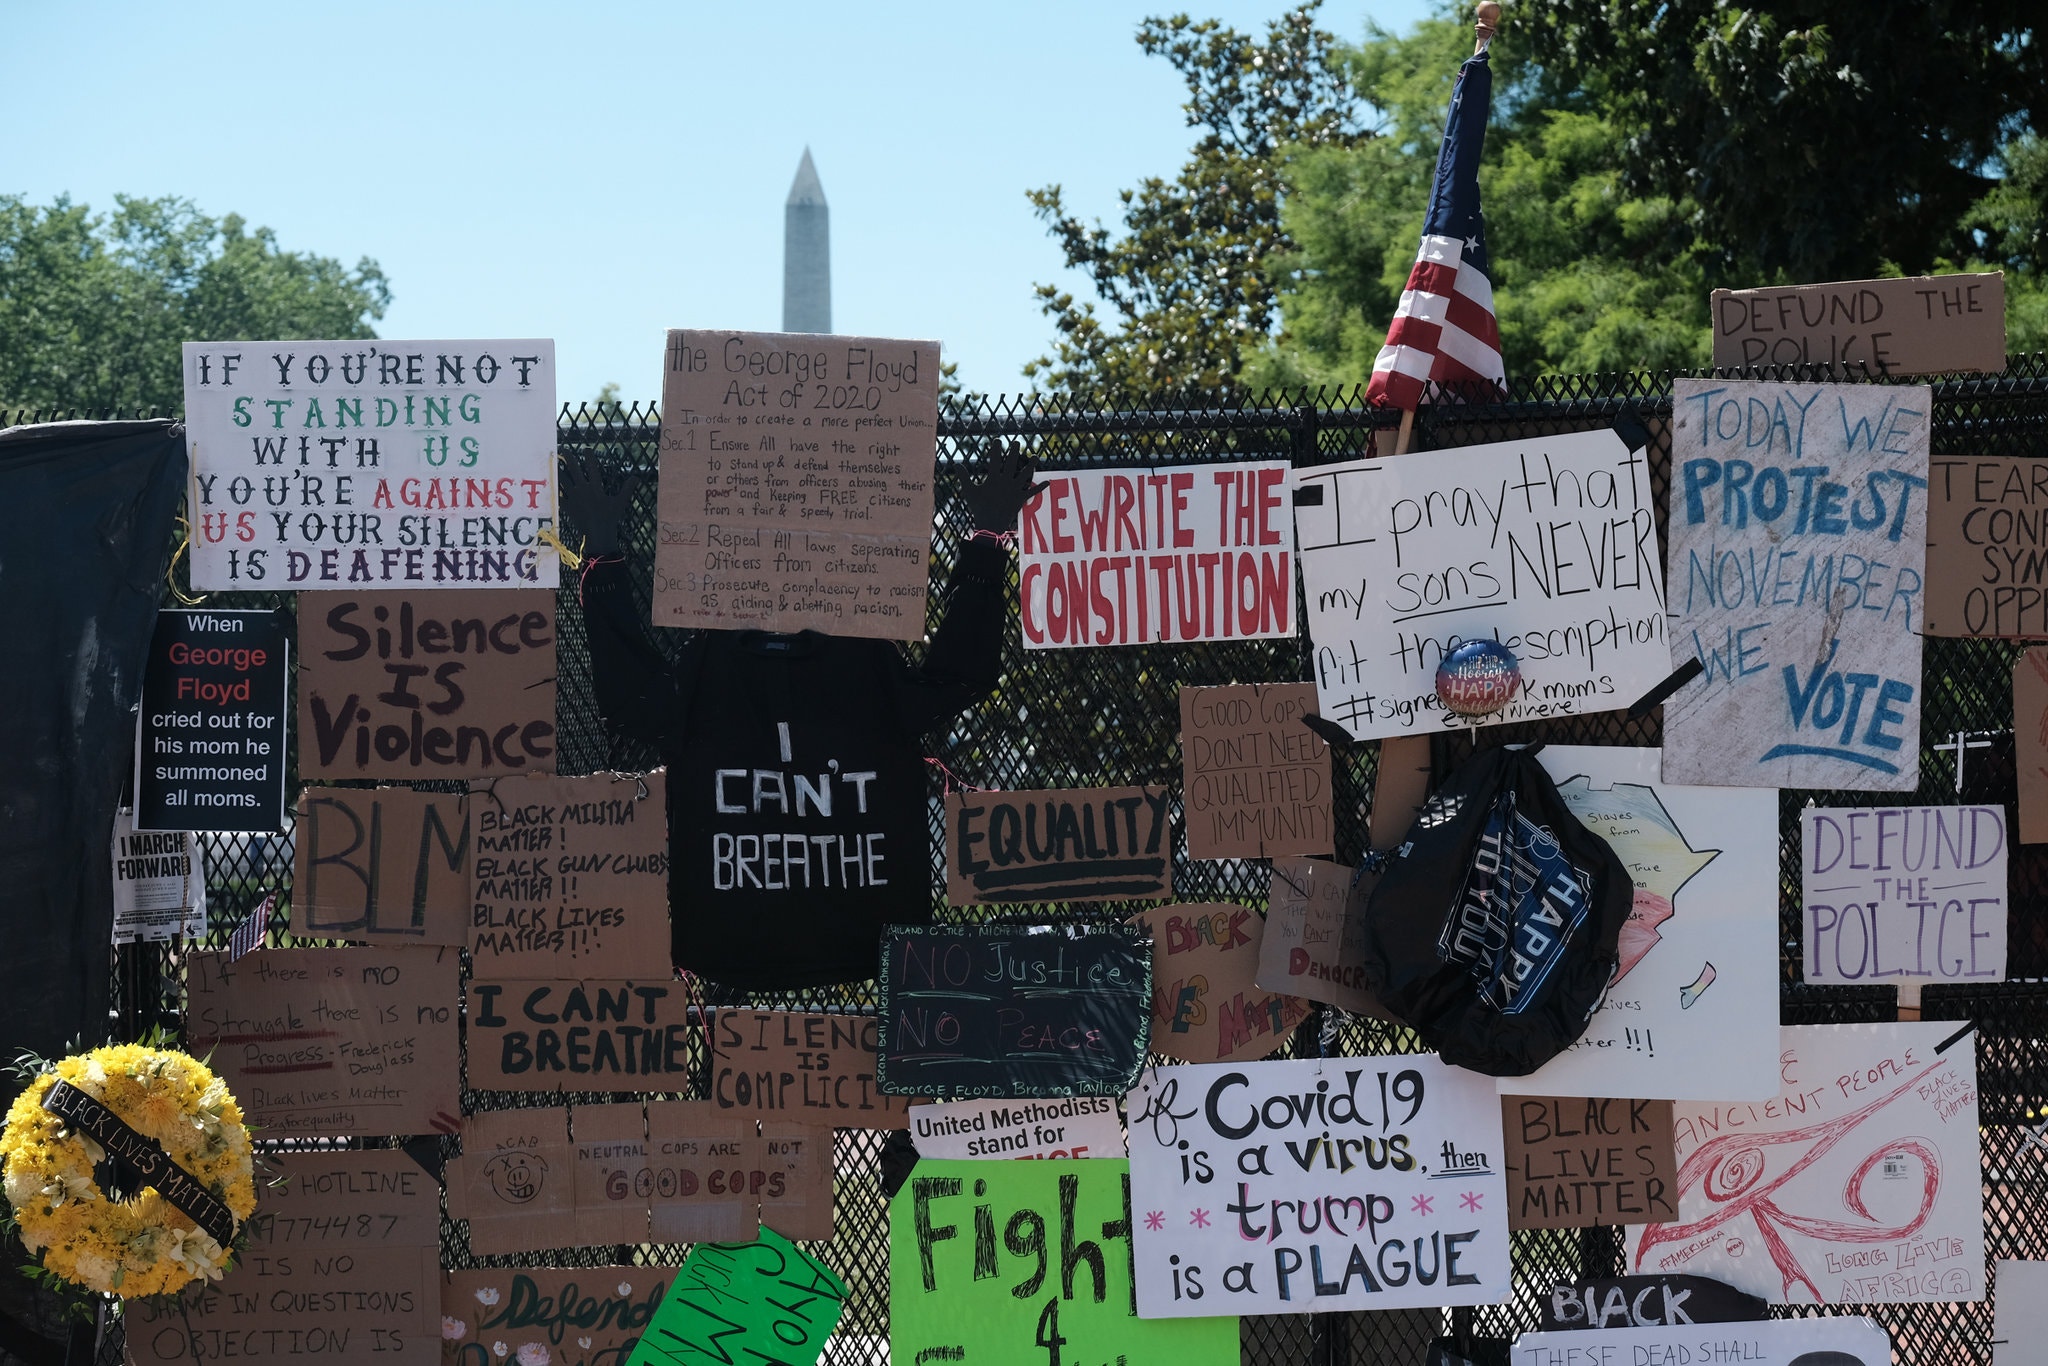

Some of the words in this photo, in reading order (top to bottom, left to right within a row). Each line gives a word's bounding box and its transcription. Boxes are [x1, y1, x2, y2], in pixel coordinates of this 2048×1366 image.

[1720, 290, 1883, 336] DEFUND
[1915, 284, 1983, 319] THE
[200, 353, 242, 386] IF
[272, 347, 425, 387] YOU'RE
[436, 352, 541, 387] NOT
[669, 334, 707, 373] the
[724, 337, 827, 382] George
[847, 348, 918, 393] Floyd
[232, 393, 482, 428] STANDING
[724, 381, 768, 406] Act
[780, 383, 803, 408] of
[814, 385, 882, 410] 2020
[1686, 388, 1823, 458] TODAY
[1839, 395, 1923, 454] WE
[252, 436, 380, 467] WITH
[424, 435, 479, 467] US
[710, 431, 749, 450] Ensure
[760, 436, 775, 451] All
[791, 438, 819, 452] have
[833, 440, 856, 453] the
[869, 443, 900, 456] right
[196, 469, 352, 506] YOU'RE
[373, 478, 547, 509] AGAINST
[1683, 458, 1927, 542] PROTEST
[1932, 462, 2048, 504] TEAR
[202, 511, 256, 543] US
[270, 511, 383, 545] YOUR
[399, 514, 553, 548] SILENCE
[1019, 473, 1194, 554] REWRITE
[1213, 468, 1284, 547] THE
[1300, 467, 1382, 551] I
[1388, 480, 1507, 568] pray
[1510, 451, 1643, 513] that
[707, 524, 760, 554] Repeal
[774, 531, 791, 548] All
[806, 535, 836, 554] laws
[851, 543, 919, 564] seperating
[1320, 579, 1366, 619] my
[1387, 562, 1500, 613] sons
[1508, 508, 1664, 610] NEVER
[228, 549, 268, 580] IS
[287, 547, 539, 583] DEAFENING
[1021, 551, 1288, 644] CONSTITUTION
[1686, 544, 1921, 634] NOVEMBER
[187, 616, 243, 632] When
[322, 601, 552, 661] Silence
[169, 643, 266, 672] George
[1692, 622, 1771, 684] WE
[177, 678, 250, 706] Floyd
[378, 662, 467, 716] IS
[1451, 677, 1512, 700] HAPPY
[1458, 666, 1503, 681] Hooray
[1543, 675, 1614, 698] moms
[1192, 688, 1252, 729] GOOD
[1781, 638, 1914, 750] VOTE
[152, 712, 201, 729] cried
[209, 714, 241, 729] out
[247, 711, 274, 729] for
[309, 689, 555, 768] Violence
[154, 737, 183, 754] his
[189, 740, 240, 754] mom
[246, 739, 270, 754] he
[777, 722, 792, 762] I
[1193, 733, 1262, 770] DON'T
[1268, 730, 1325, 762] NEED
[155, 764, 267, 781] summoned
[715, 759, 876, 816] CAN'T
[1193, 767, 1320, 811] QUALIFIED
[165, 790, 187, 806] all
[194, 793, 261, 806] moms.
[480, 804, 556, 831] BLACK
[560, 801, 634, 826] MILITIA
[1588, 812, 1632, 823] Slaves
[958, 790, 1167, 877] EQUALITY
[1212, 803, 1330, 844] IMMUNITY
[1609, 827, 1640, 837] from
[1813, 808, 2003, 874] DEFUND
[121, 837, 126, 856] I
[129, 833, 184, 856] MARCH
[713, 833, 888, 890] BREATHE
[117, 856, 191, 880] FORWARD
[306, 797, 470, 935] BLM
[476, 858, 548, 879] BLACK
[558, 854, 610, 873] GUN
[1629, 864, 1661, 872] True
[1874, 877, 1929, 901] THE
[474, 904, 547, 929] BLACK
[557, 906, 625, 929] LIVES
[1808, 899, 2000, 979] POLICE
[197, 954, 236, 993] If
[254, 960, 308, 982] there
[327, 967, 344, 977] is
[902, 941, 971, 989] NO
[984, 942, 1132, 984] Justice
[202, 1003, 303, 1035] Struggle
[312, 1000, 361, 1022] there
[376, 1005, 399, 1024] is
[417, 1005, 449, 1024] no
[474, 986, 506, 1028] I
[523, 981, 669, 1024] CAN'T
[897, 1008, 960, 1050] NO
[997, 1008, 1104, 1049] PEACE
[243, 1044, 323, 1064] Progress
[339, 1037, 416, 1058] Frederick
[349, 1053, 414, 1076] Douglass
[502, 1026, 686, 1074] BREATHE
[796, 1054, 830, 1071] IS
[917, 1112, 985, 1138] United
[991, 1098, 1110, 1129] Methodists
[1135, 1078, 1198, 1147] if
[1204, 1070, 1372, 1140] Covid
[1377, 1069, 1425, 1134] 19
[1521, 1098, 1651, 1144] BLACK
[1673, 1088, 1824, 1154] ANCIENT
[1836, 1048, 1921, 1098] PEOPLE
[496, 1136, 538, 1149] ACAB
[579, 1145, 648, 1159] NEUTRAL
[662, 1143, 697, 1155] COPS
[708, 1143, 740, 1155] ARE
[768, 1142, 802, 1154] NOT
[968, 1130, 1028, 1156] stand
[1034, 1126, 1065, 1146] for
[1178, 1140, 1214, 1185] is
[1237, 1145, 1273, 1175] a
[1285, 1132, 1428, 1175] virus,
[1440, 1140, 1490, 1168] then
[51, 1084, 111, 1137] BLACK
[108, 1127, 161, 1174] LIVES
[157, 1167, 231, 1239] MATTER
[1525, 1146, 1655, 1182] LIVES
[303, 1171, 419, 1196] HOTLINE
[1522, 1178, 1673, 1218] MATTER
[1227, 1182, 1394, 1245] trump
[254, 1257, 291, 1276] IS
[315, 1256, 353, 1276] NO
[1170, 1255, 1204, 1300] is
[1223, 1263, 1258, 1293] a
[1275, 1229, 1481, 1300] PLAGUE
[1825, 1249, 1888, 1273] LONG
[229, 1293, 259, 1313] IN
[270, 1291, 414, 1315] QUESTIONS
[1839, 1269, 1972, 1304] AFRICA
[152, 1327, 349, 1360] OBJECTION
[371, 1329, 404, 1351] IS
[1699, 1341, 1767, 1362] SHALL
